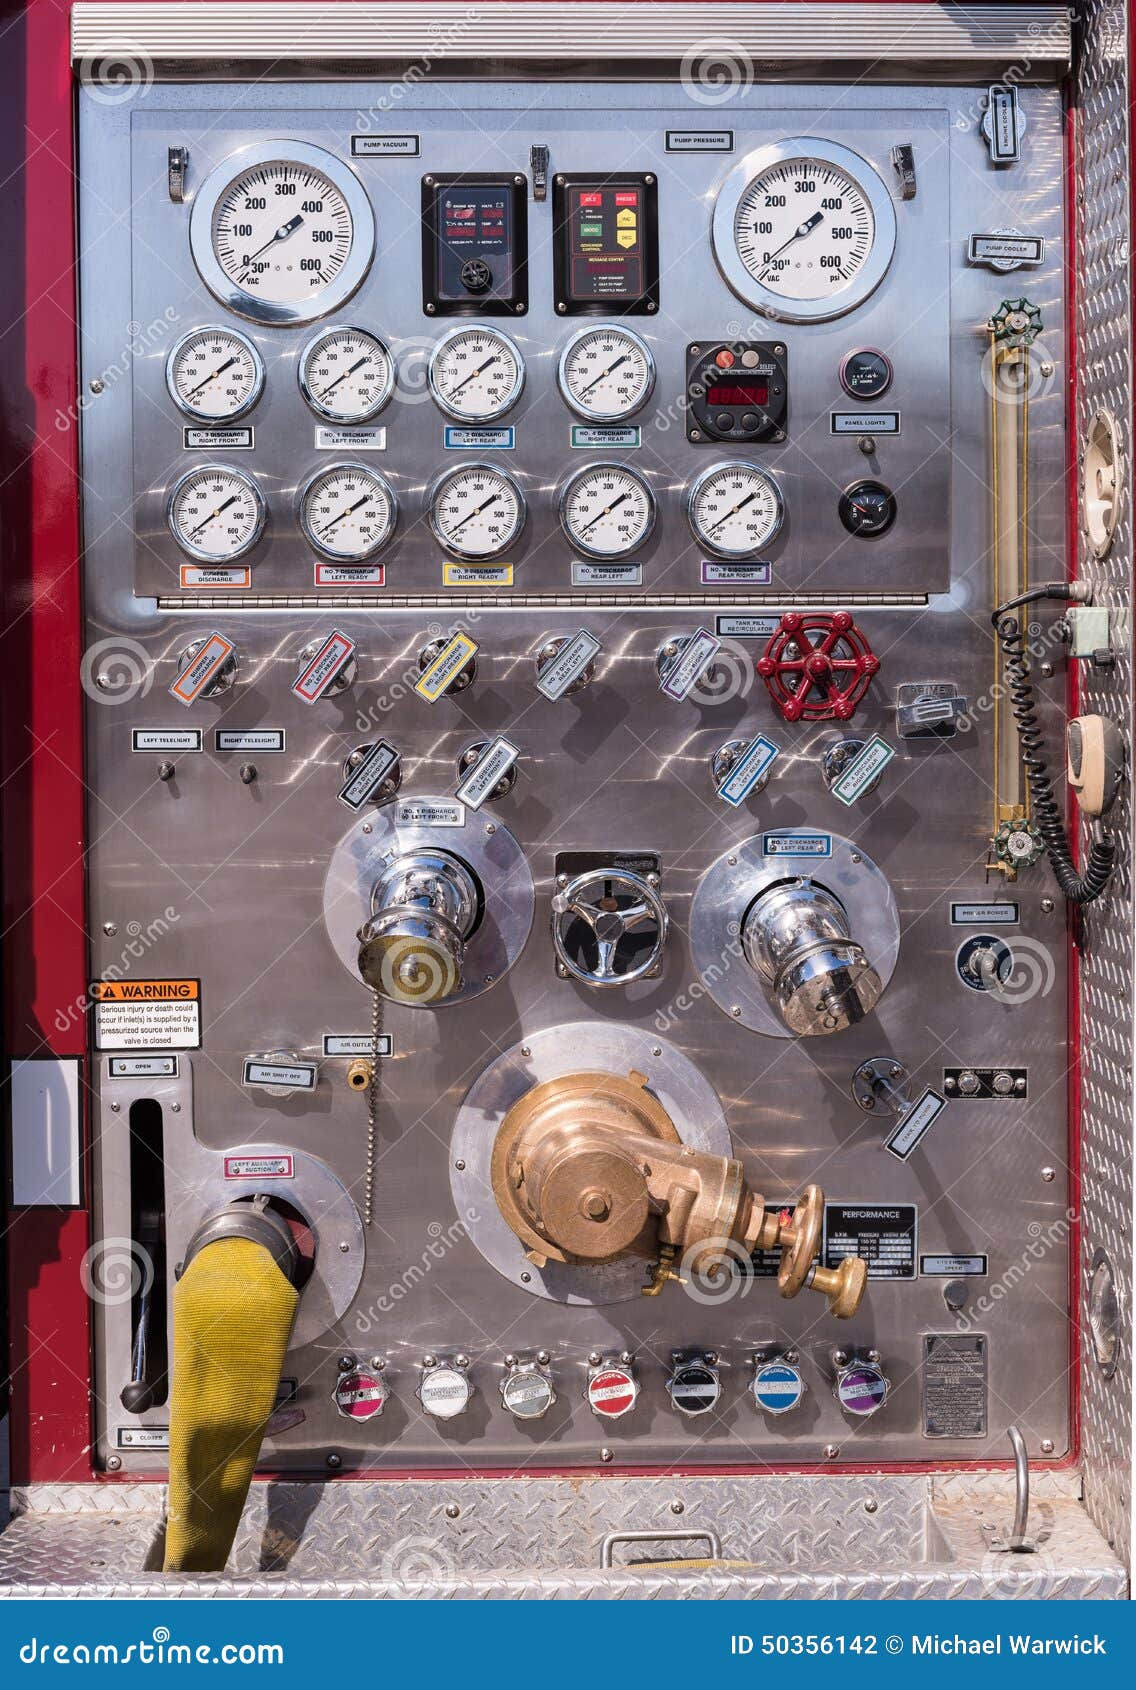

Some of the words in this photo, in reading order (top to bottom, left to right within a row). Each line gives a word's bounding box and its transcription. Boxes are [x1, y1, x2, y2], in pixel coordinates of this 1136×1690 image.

[275, 184, 296, 195] 300
[794, 181, 815, 193] 300
[245, 198, 266, 210] 200
[301, 201, 323, 213] 400
[765, 195, 786, 207] 200
[821, 198, 843, 210] 400
[233, 225, 252, 236] 100
[753, 222, 772, 234] 100
[832, 228, 852, 239] 500
[312, 231, 333, 242] 500
[243, 255, 250, 266] 0
[763, 252, 770, 264] 0
[820, 256, 841, 267] 600
[300, 259, 321, 271] 600
[310, 277, 321, 285] psi
[830, 274, 840, 282] psi
[314, 644, 338, 674] DISCHARGE
[437, 643, 462, 673] DISCHARGE
[559, 643, 584, 671] DISCHARGE
[190, 655, 209, 678] BUMPER
[192, 655, 216, 685] DISCHARGE
[313, 670, 325, 685] LEFT
[323, 653, 339, 671] READY
[434, 669, 448, 685] RIGHT
[447, 653, 462, 670] READY
[558, 667, 571, 681] REAR
[570, 654, 581, 668] LEFT
[911, 685, 946, 695] PRIME
[360, 752, 384, 781] DISCHARGE
[479, 750, 504, 780] DISCHARGE
[854, 748, 880, 775] DISCHARGE
[358, 778, 371, 794] RIGHT
[370, 760, 385, 778] FRONT
[477, 777, 489, 791] LEFT
[488, 760, 501, 778] FRONT
[852, 772, 866, 788] RIGHT
[866, 758, 879, 773] REAR
[120, 984, 191, 998] WARNING
[127, 1005, 145, 1014] injury
[123, 1016, 145, 1024] inlet(s)
[153, 1015, 181, 1024] supplied
[183, 1015, 191, 1023] by
[101, 1027, 139, 1035] pressurized
[149, 1036, 171, 1044] closed
[842, 1211, 900, 1219] PERFORMANCE
